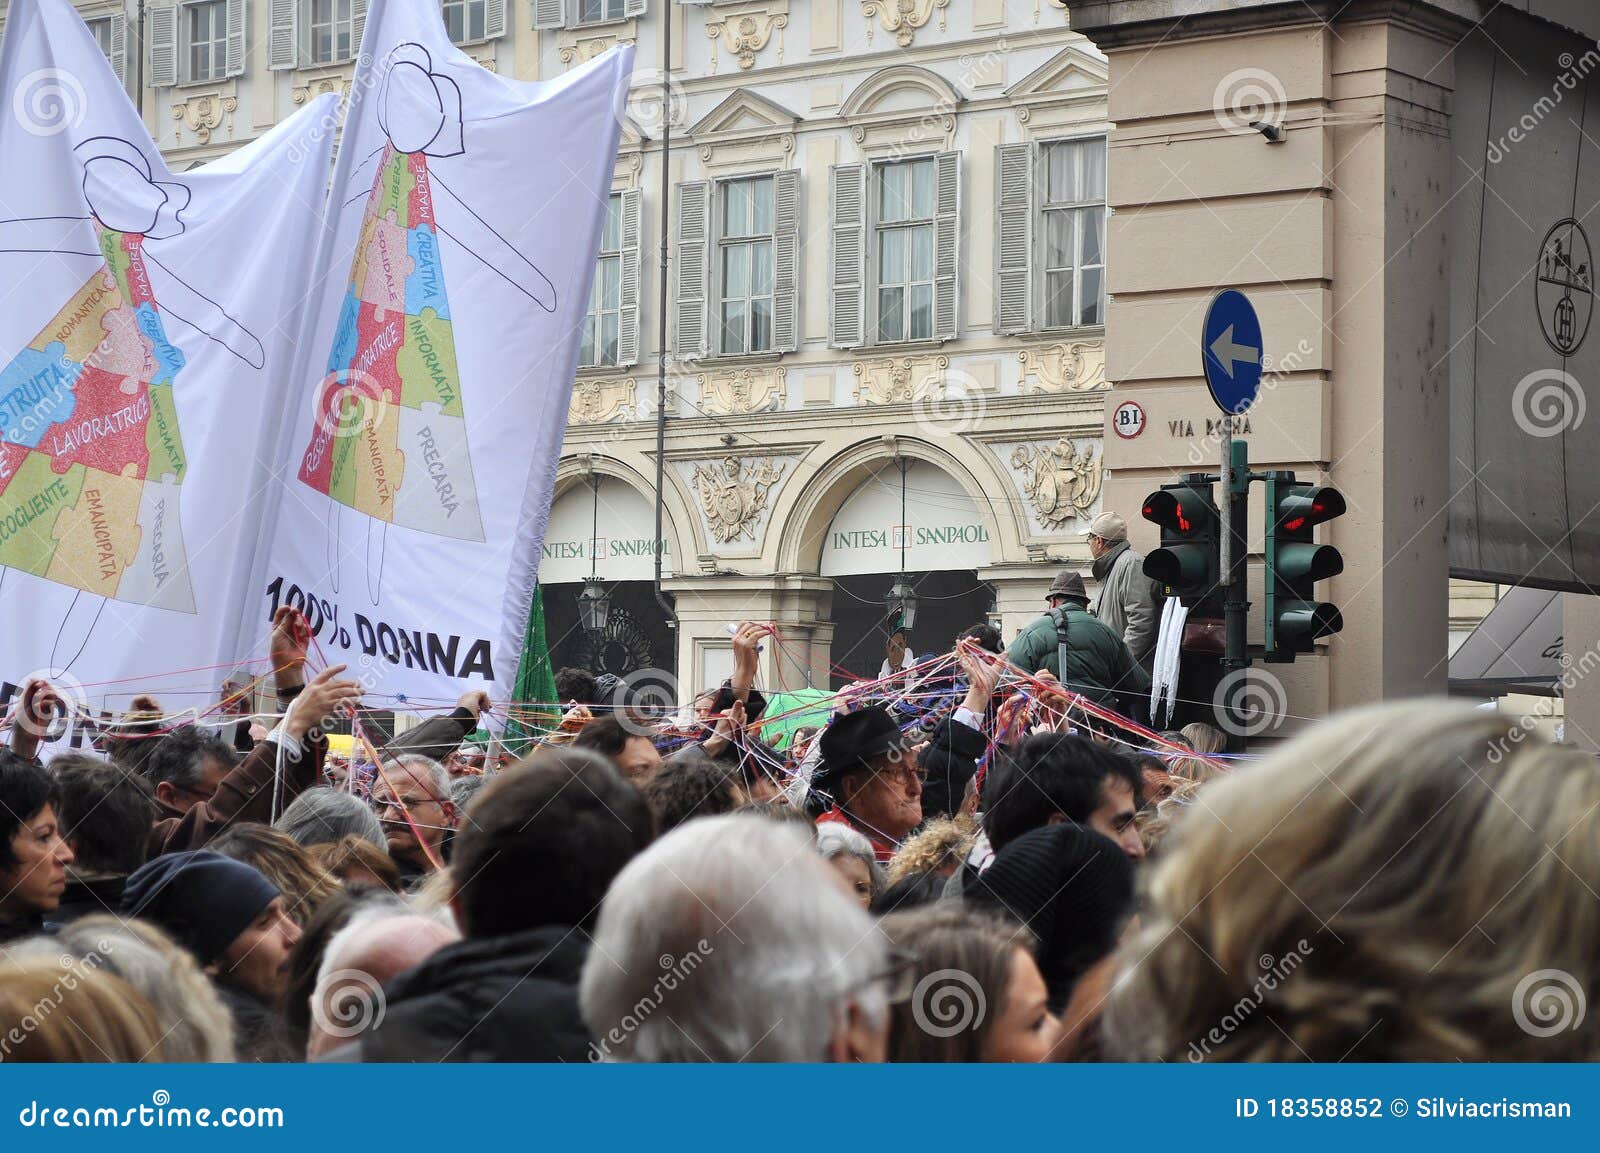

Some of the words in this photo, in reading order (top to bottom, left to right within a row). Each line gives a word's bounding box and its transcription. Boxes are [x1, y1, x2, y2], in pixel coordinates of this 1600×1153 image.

[415, 164, 430, 218] MADRE
[128, 241, 150, 297] MADRE
[377, 230, 398, 301] SOLIDALE
[415, 231, 439, 299] CREATIVA
[56, 286, 108, 343] ROMANTICA
[350, 321, 399, 390] LAVORATRICE
[409, 319, 456, 405] INFORMATA
[53, 393, 149, 457] LAVORATRICE
[149, 389, 185, 476] INFORMATA
[1168, 419, 1194, 438] VIA
[365, 418, 391, 505] EMANCIPATA
[416, 425, 461, 519] PRECARIA
[0, 477, 70, 545] COGLIENTE
[84, 489, 117, 581] EMANCIPATA
[152, 498, 171, 588] PRECARIA
[833, 527, 888, 550] INTESA
[916, 524, 989, 545] SANPAOL
[541, 541, 585, 560] NTESA
[610, 538, 672, 557] SANPAOL
[266, 577, 350, 650] 100%
[354, 612, 495, 681] DONNA
